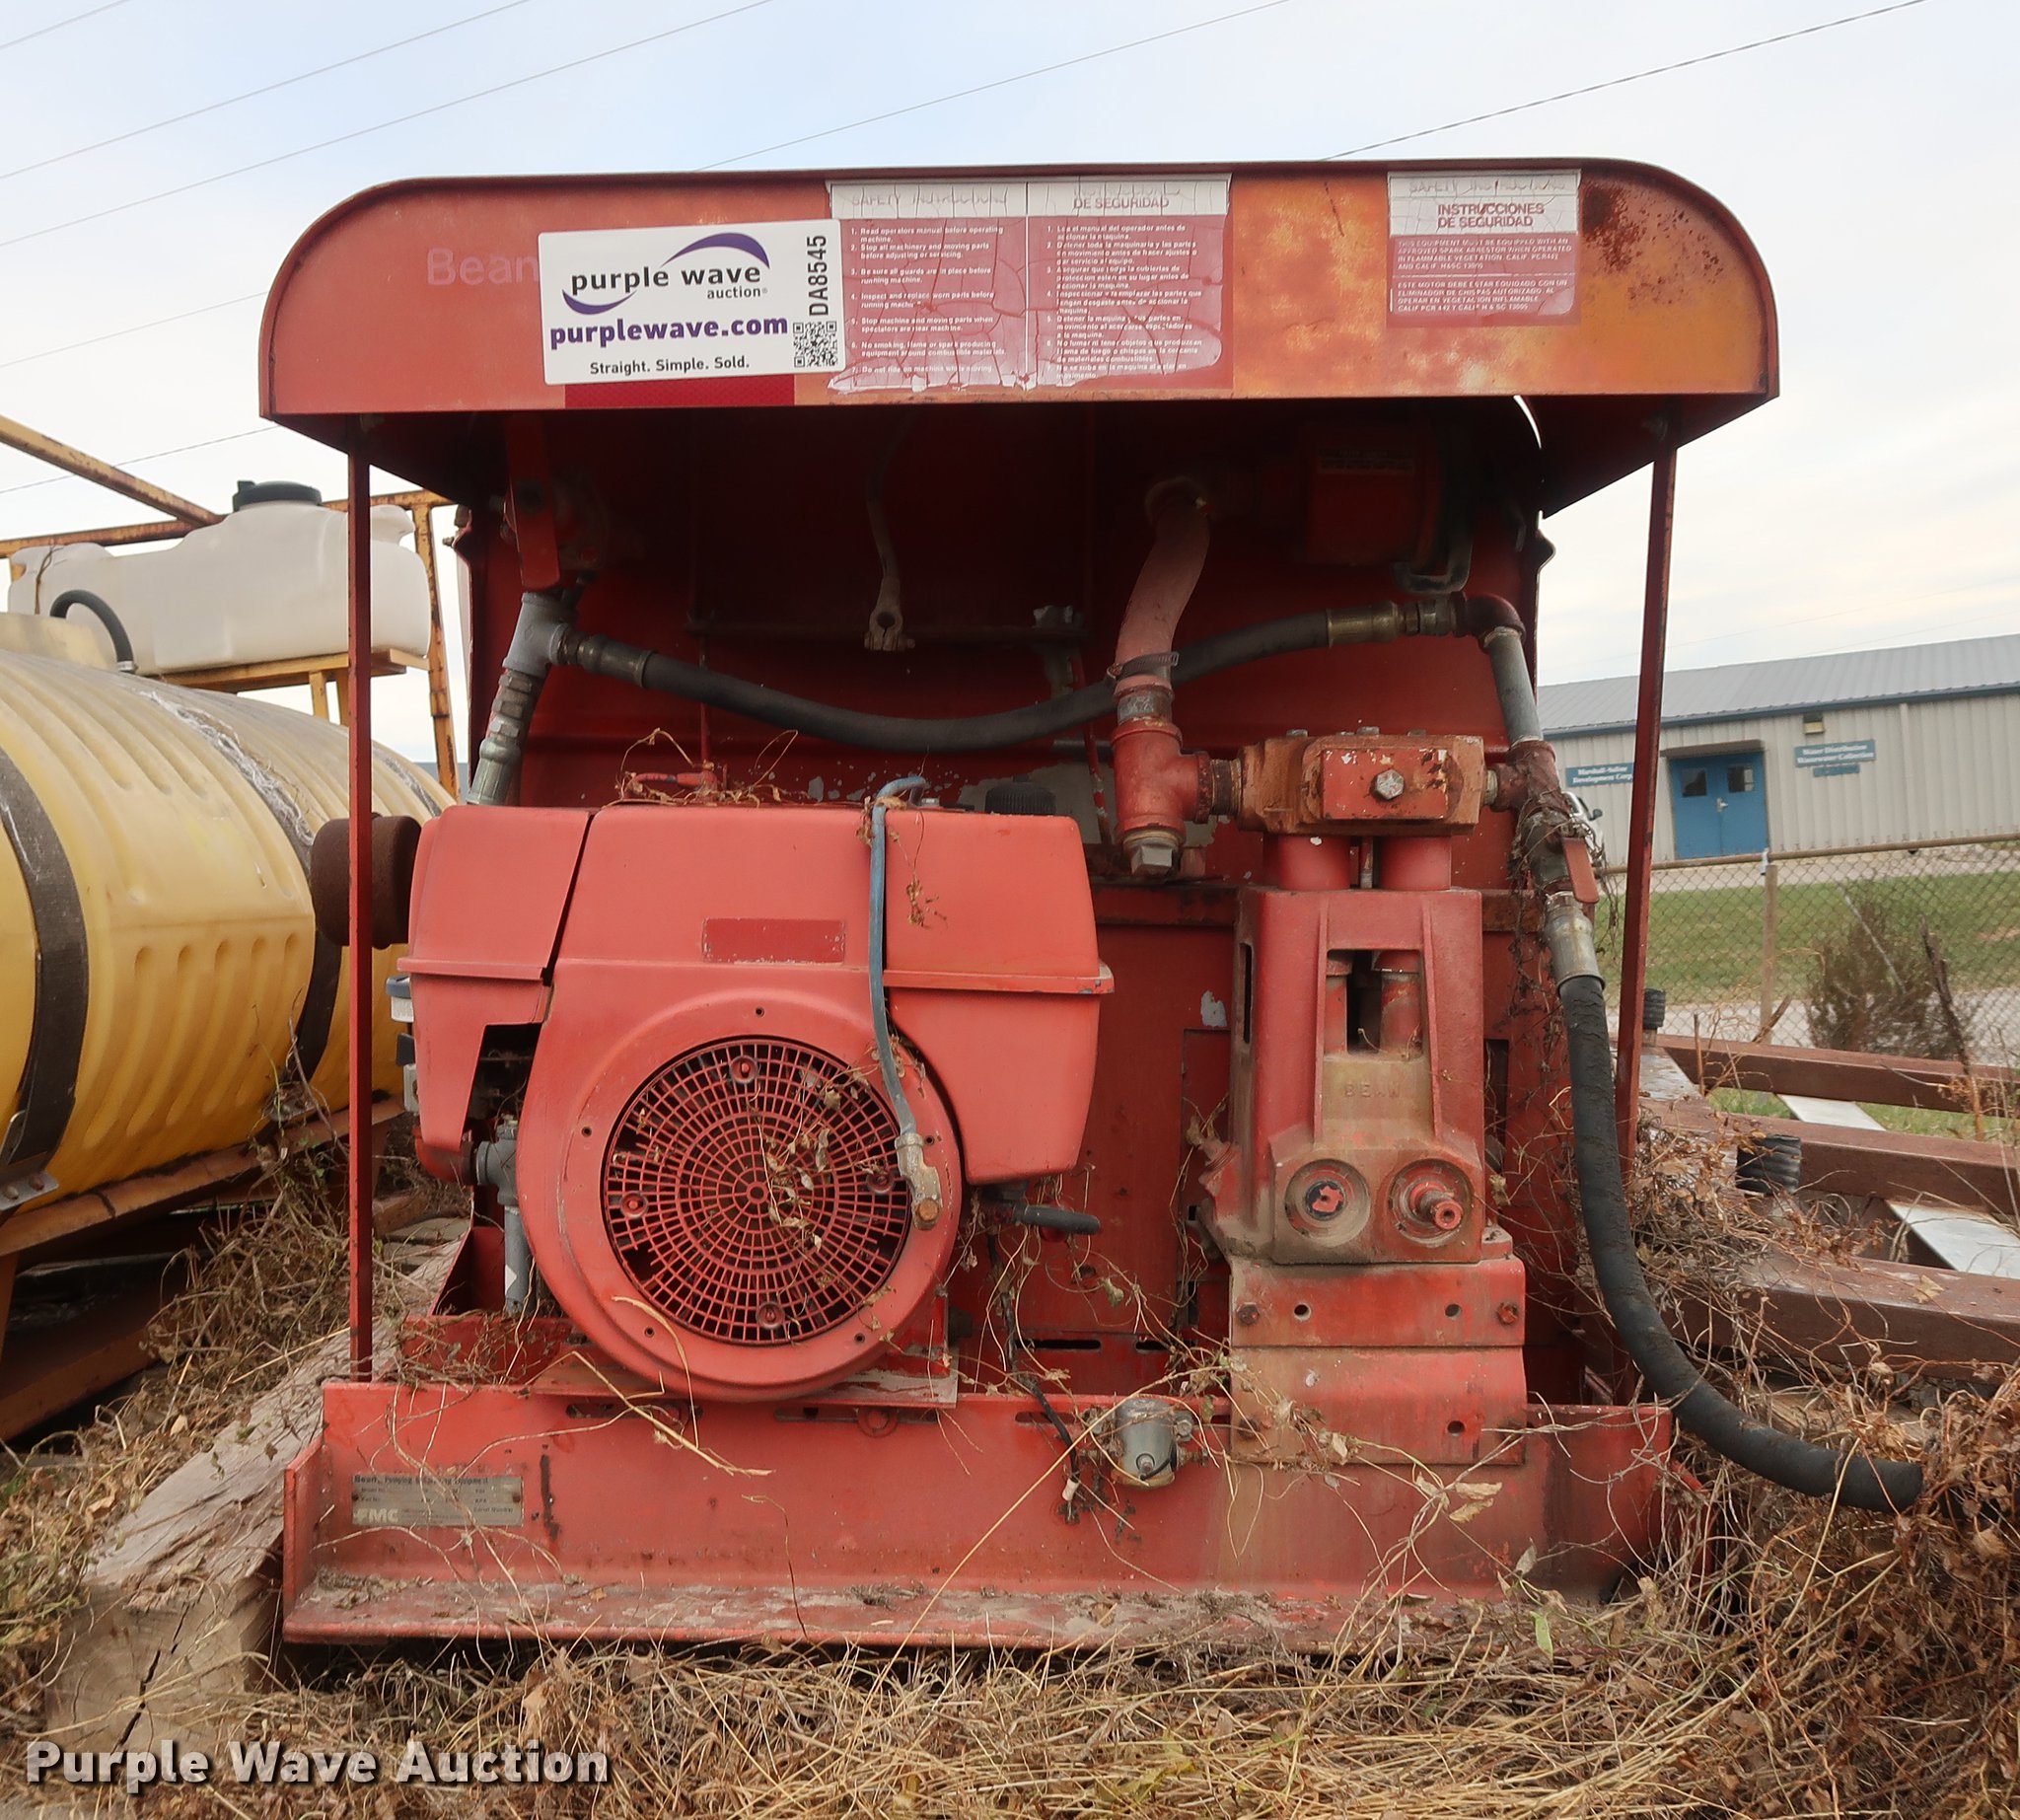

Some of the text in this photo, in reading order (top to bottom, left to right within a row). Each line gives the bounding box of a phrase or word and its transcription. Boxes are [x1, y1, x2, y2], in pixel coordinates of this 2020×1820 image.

[1074, 197, 1169, 209] DE SEGURIDAD
[1438, 216, 1533, 228] DE SEGURIDAD
[426, 247, 540, 286] Bean
[571, 266, 760, 295] purple wave
[807, 235, 829, 316] DA8545
[550, 317, 788, 350] purplewave.com
[590, 356, 750, 376] Straight. Simple. Sold.
